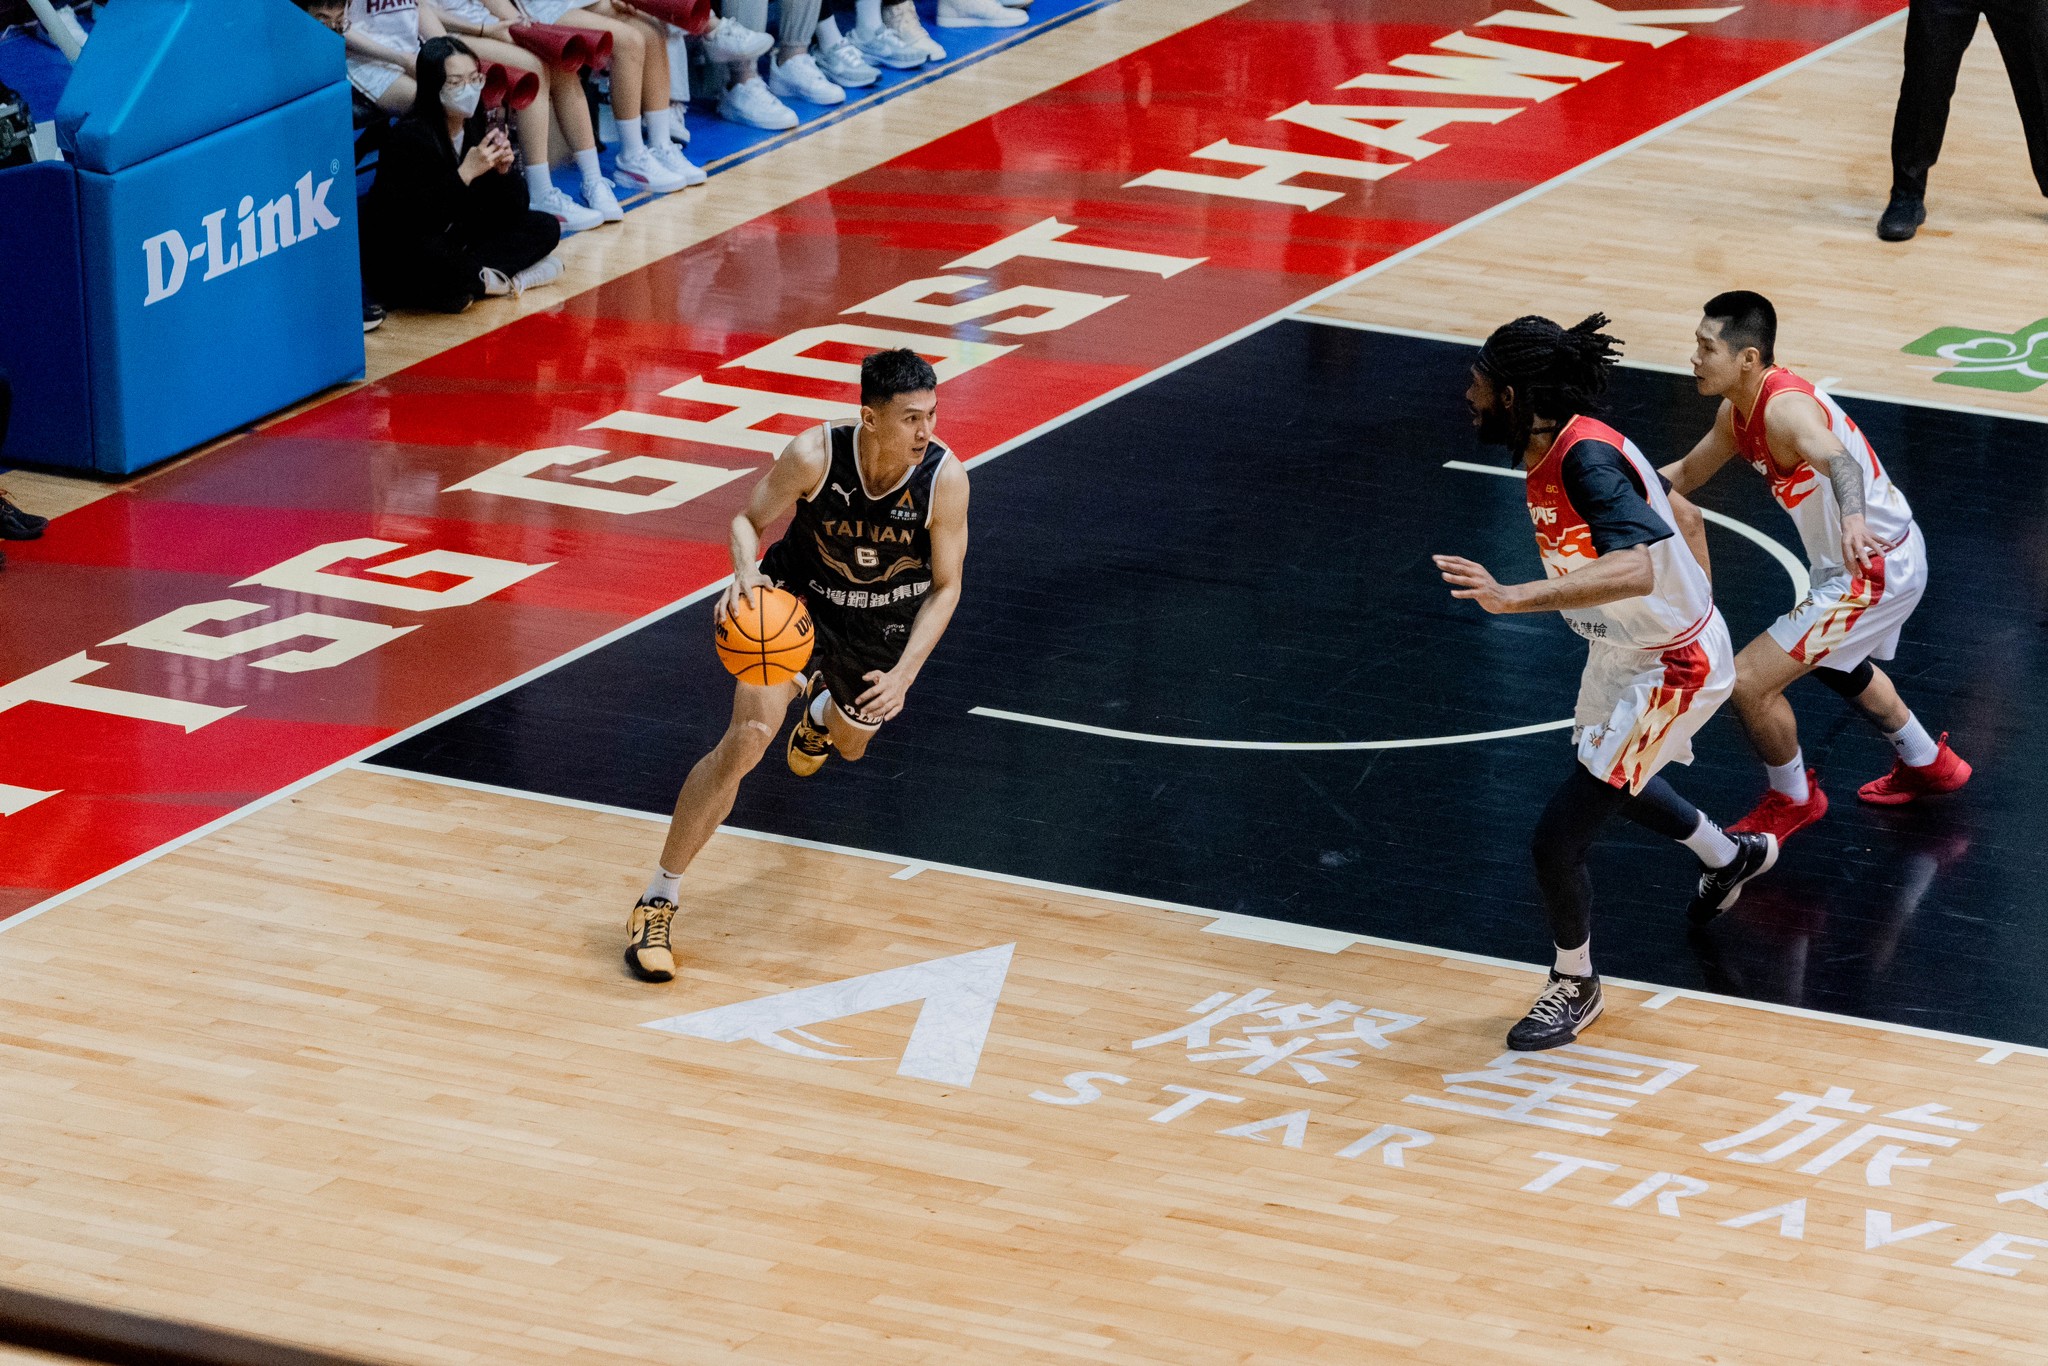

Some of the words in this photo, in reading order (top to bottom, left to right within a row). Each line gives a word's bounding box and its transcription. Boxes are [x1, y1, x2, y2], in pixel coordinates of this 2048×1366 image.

[142, 170, 341, 307] D-Link
[0, 538, 560, 734] TSG
[440, 214, 1210, 516] GHOST
[1120, 0, 1746, 212] HAWK
[822, 520, 916, 546] TAINAN
[1028, 1071, 1436, 1167] STAR
[1520, 1151, 2048, 1278] TRAVE
[1131, 987, 2048, 1211] 燦星旅
